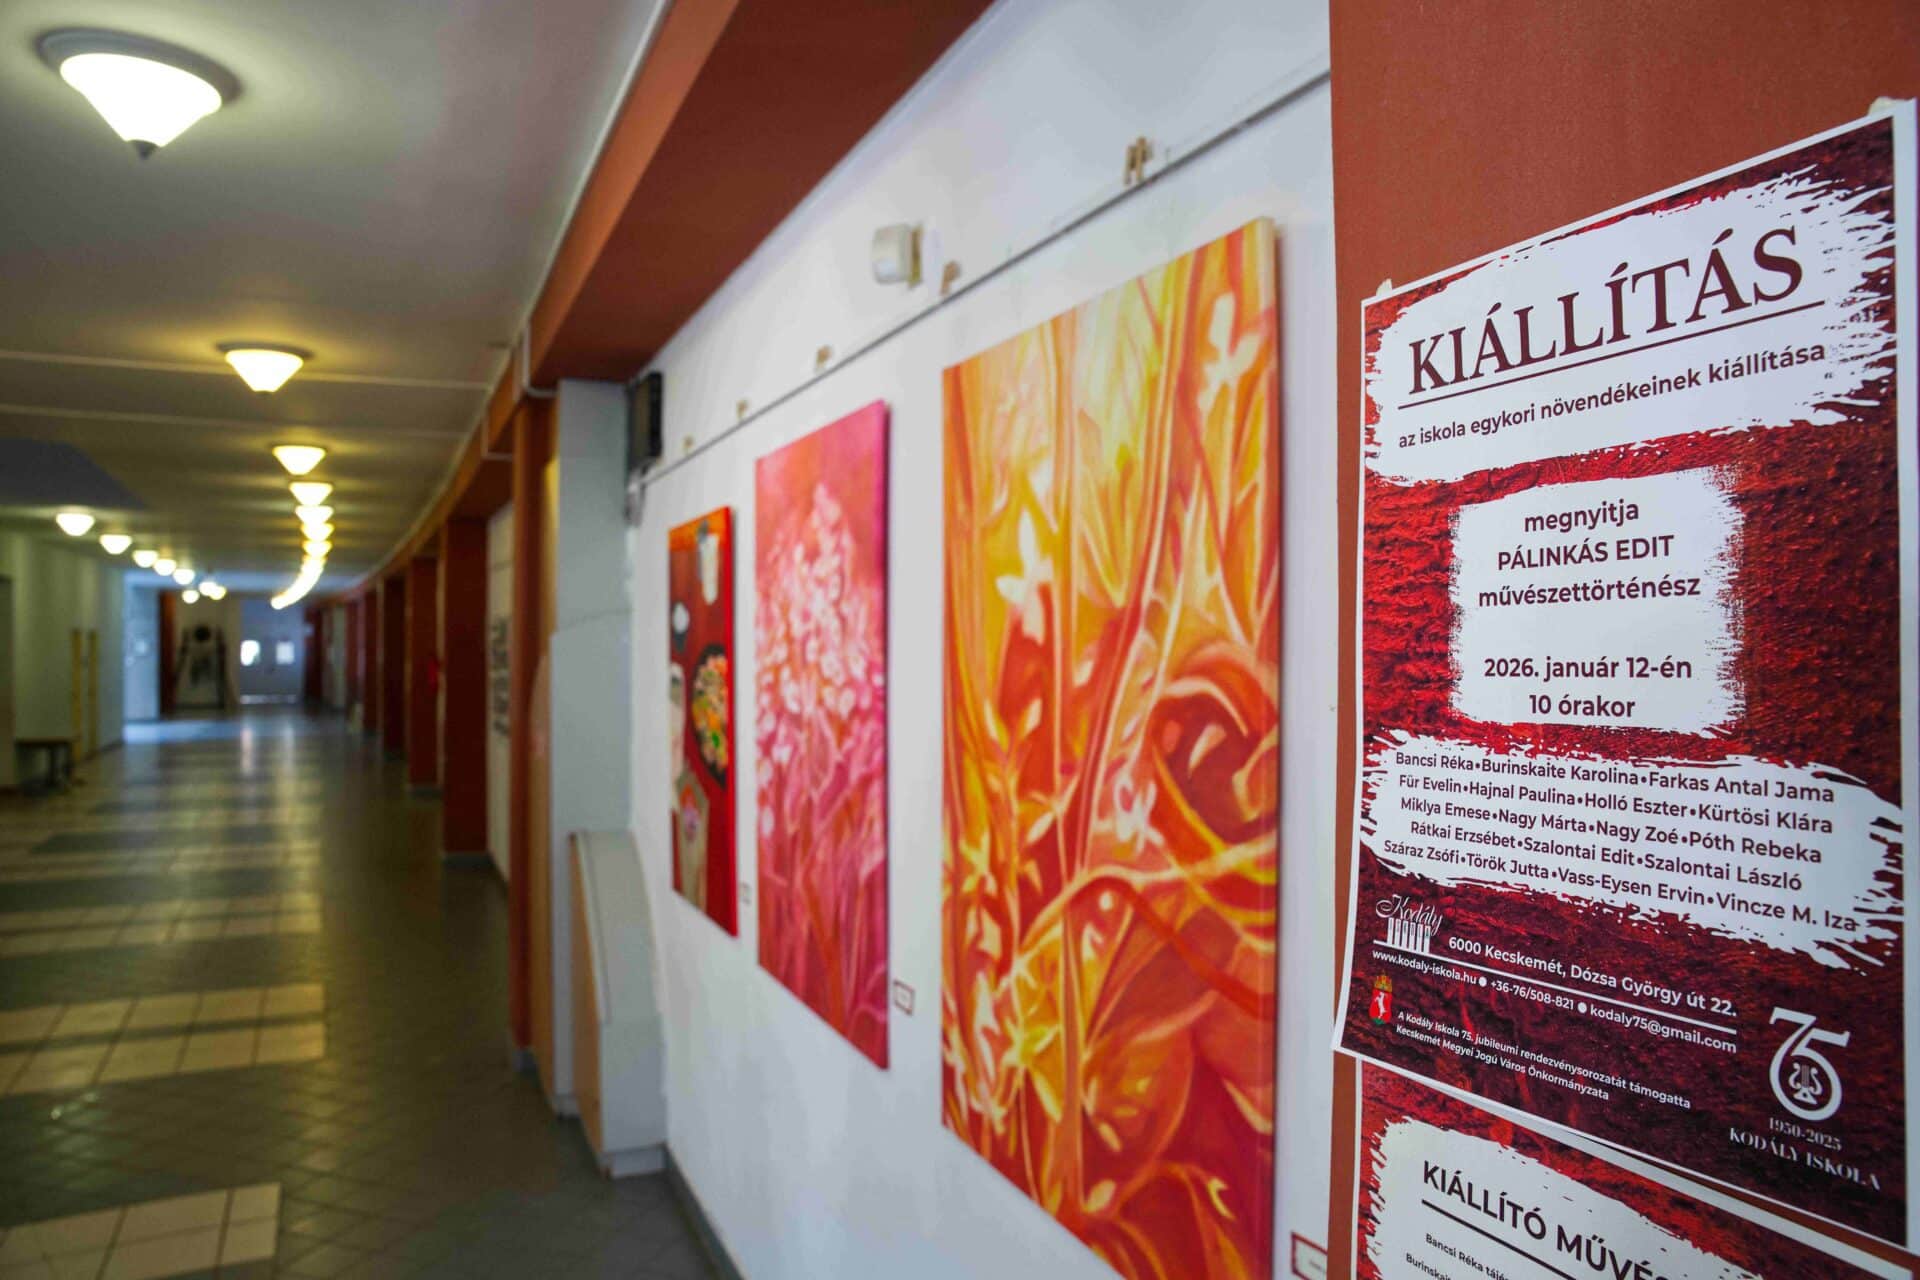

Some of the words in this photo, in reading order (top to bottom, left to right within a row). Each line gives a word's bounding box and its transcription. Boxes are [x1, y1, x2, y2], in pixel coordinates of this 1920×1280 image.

[1408, 226, 1803, 394] KIÁLLÍTÁS
[1399, 432, 1416, 448] az
[1420, 420, 1466, 444] iskola
[1471, 403, 1536, 438] egykori
[1541, 368, 1701, 420] növendékeinek
[1708, 343, 1826, 383] kiállítása
[1524, 499, 1639, 533] megnyitja
[1498, 538, 1608, 571] PÁLINKÁS
[1616, 535, 1674, 560] EDIT
[1479, 575, 1701, 607] művészettörténész
[1484, 658, 1539, 677] 2026.
[1543, 656, 1619, 682] január
[1626, 655, 1692, 678] 12-én
[1529, 695, 1551, 714] 10
[1558, 695, 1635, 717] órakor
[1396, 752, 1437, 768] Bancsi
[1714, 777, 1768, 797] Antal
[1775, 781, 1834, 803] Jama
[1399, 774, 1419, 788] Für
[1777, 810, 1833, 833] Klára
[1400, 797, 1441, 815] Miklya
[1742, 837, 1822, 863] Rebeka
[1411, 821, 1451, 840] Rátkai
[1737, 865, 1802, 891] László
[1376, 894, 1443, 937] Kodály
[1384, 840, 1423, 858] Száraz
[1792, 905, 1817, 925] M.
[1825, 910, 1857, 932] Iza
[1372, 950, 1477, 985] www.kodaly-iskola.hu
[1490, 979, 1574, 1010] +36-76/508-821
[1590, 1003, 1737, 1053] kodaly75@gmail.com
[1448, 936, 1481, 955] 6000
[1485, 945, 1566, 978] Kecskemét,
[1571, 964, 1617, 988] Dózsa
[1622, 976, 1682, 1006] György
[1687, 991, 1705, 1009] út
[1711, 997, 1737, 1016] 22.
[1396, 1024, 1441, 1046] Kecskemét
[1443, 1039, 1474, 1057] Megyei
[1475, 1049, 1497, 1065] Jogú
[1500, 1056, 1525, 1073] Város
[1528, 1063, 1609, 1100] Önkormányzata
[1398, 1011, 1404, 1019] A
[1406, 1013, 1434, 1030] Kodály
[1461, 1030, 1473, 1041] 75.
[1474, 1033, 1519, 1055] jubileumi
[1521, 1048, 1627, 1089] rendezvénysorozatát
[1629, 1081, 1691, 1109] támogatta
[1769, 1006, 1850, 1121] 75
[1730, 1127, 1798, 1161] KODÁLY
[1806, 1152, 1880, 1190] ISKOLA
[1769, 1117, 1842, 1151] 1950-2025
[1423, 1160, 1546, 1240] KIÁLLÍTÓ
[1556, 1224, 1668, 1280] MŰVÉ
[1425, 1233, 1457, 1257] Bancsi
[1459, 1251, 1483, 1272] Réka
